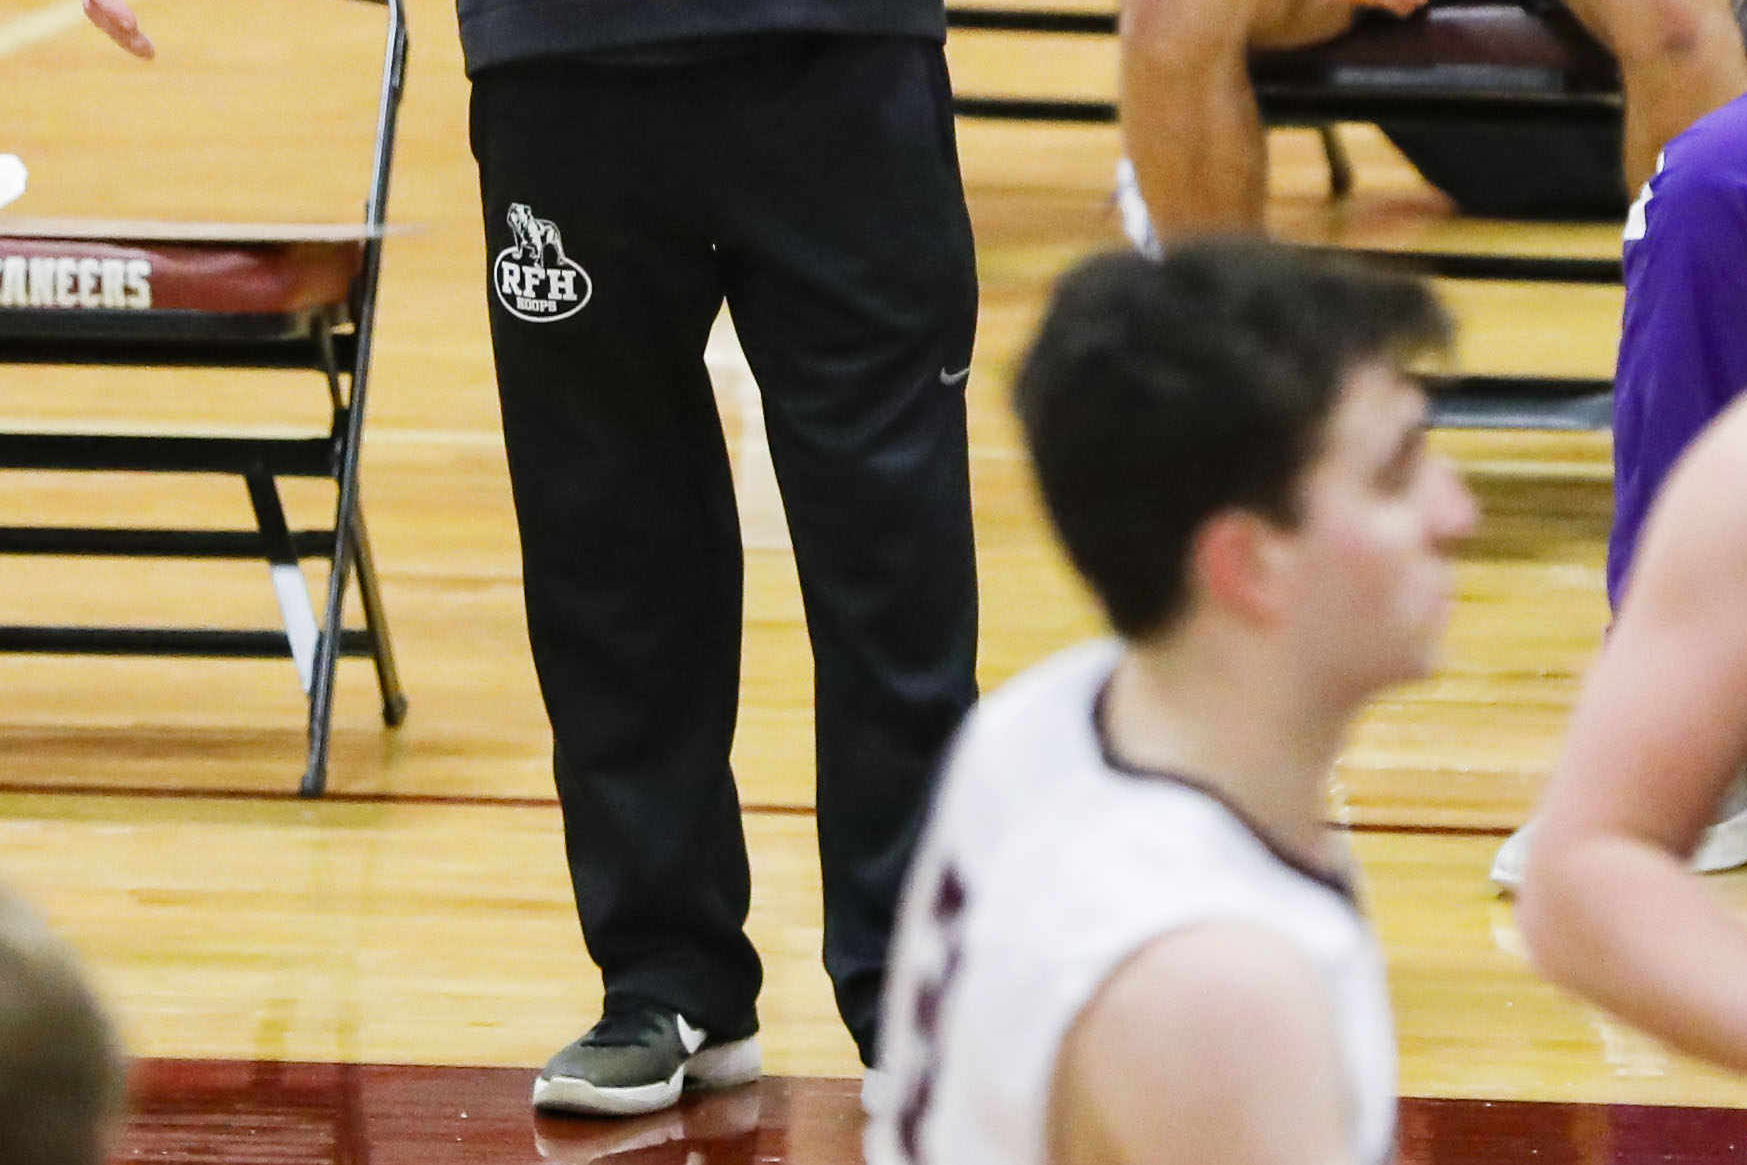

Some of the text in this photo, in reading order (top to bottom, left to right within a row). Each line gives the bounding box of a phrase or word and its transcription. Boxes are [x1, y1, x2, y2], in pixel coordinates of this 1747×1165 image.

[0, 255, 152, 309] ANEERS
[502, 261, 577, 301] RFH
[516, 297, 557, 312] HOOPS
